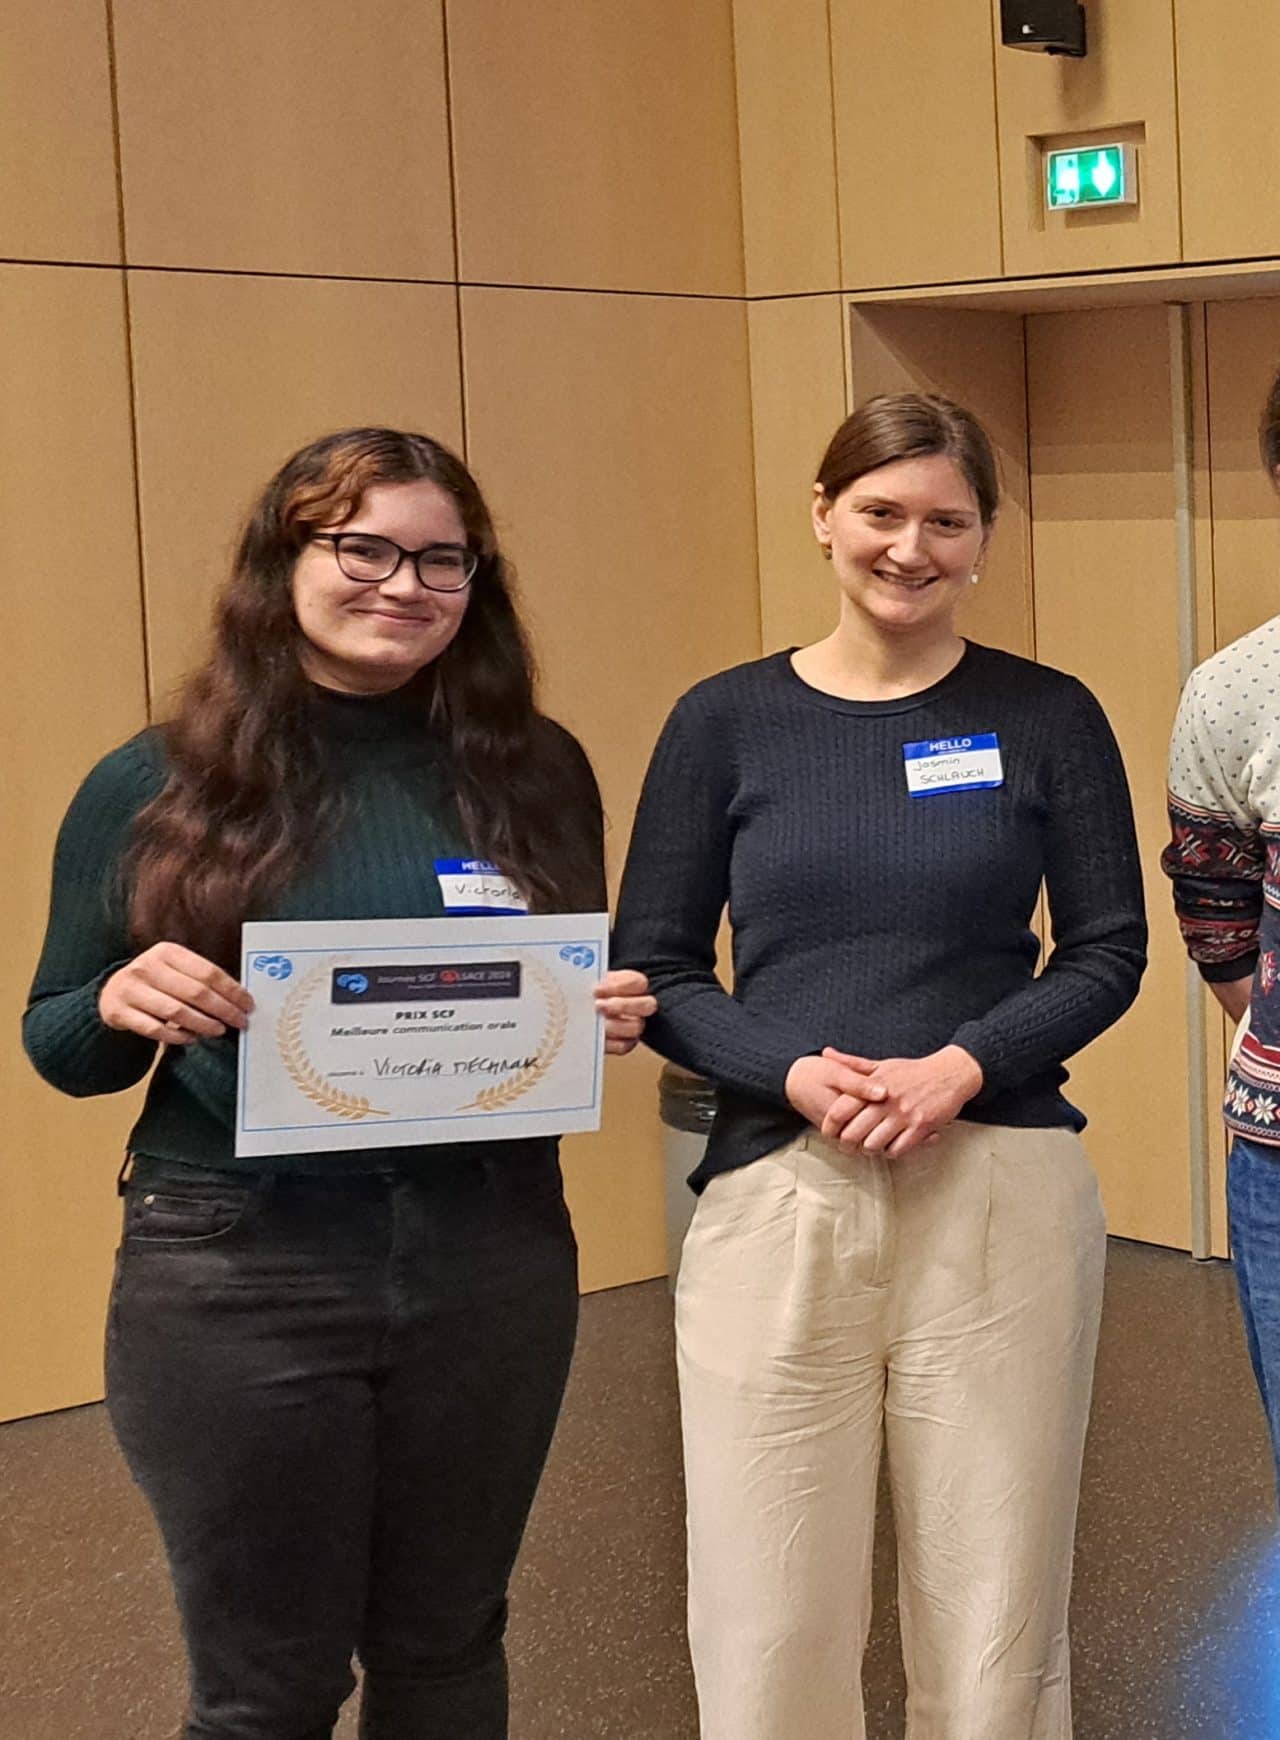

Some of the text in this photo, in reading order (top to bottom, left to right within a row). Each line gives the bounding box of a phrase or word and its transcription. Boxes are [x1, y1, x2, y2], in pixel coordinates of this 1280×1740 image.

[929, 738, 972, 752] HELLO
[395, 1011, 428, 1020] PRIX
[393, 1022, 483, 1034] communication
